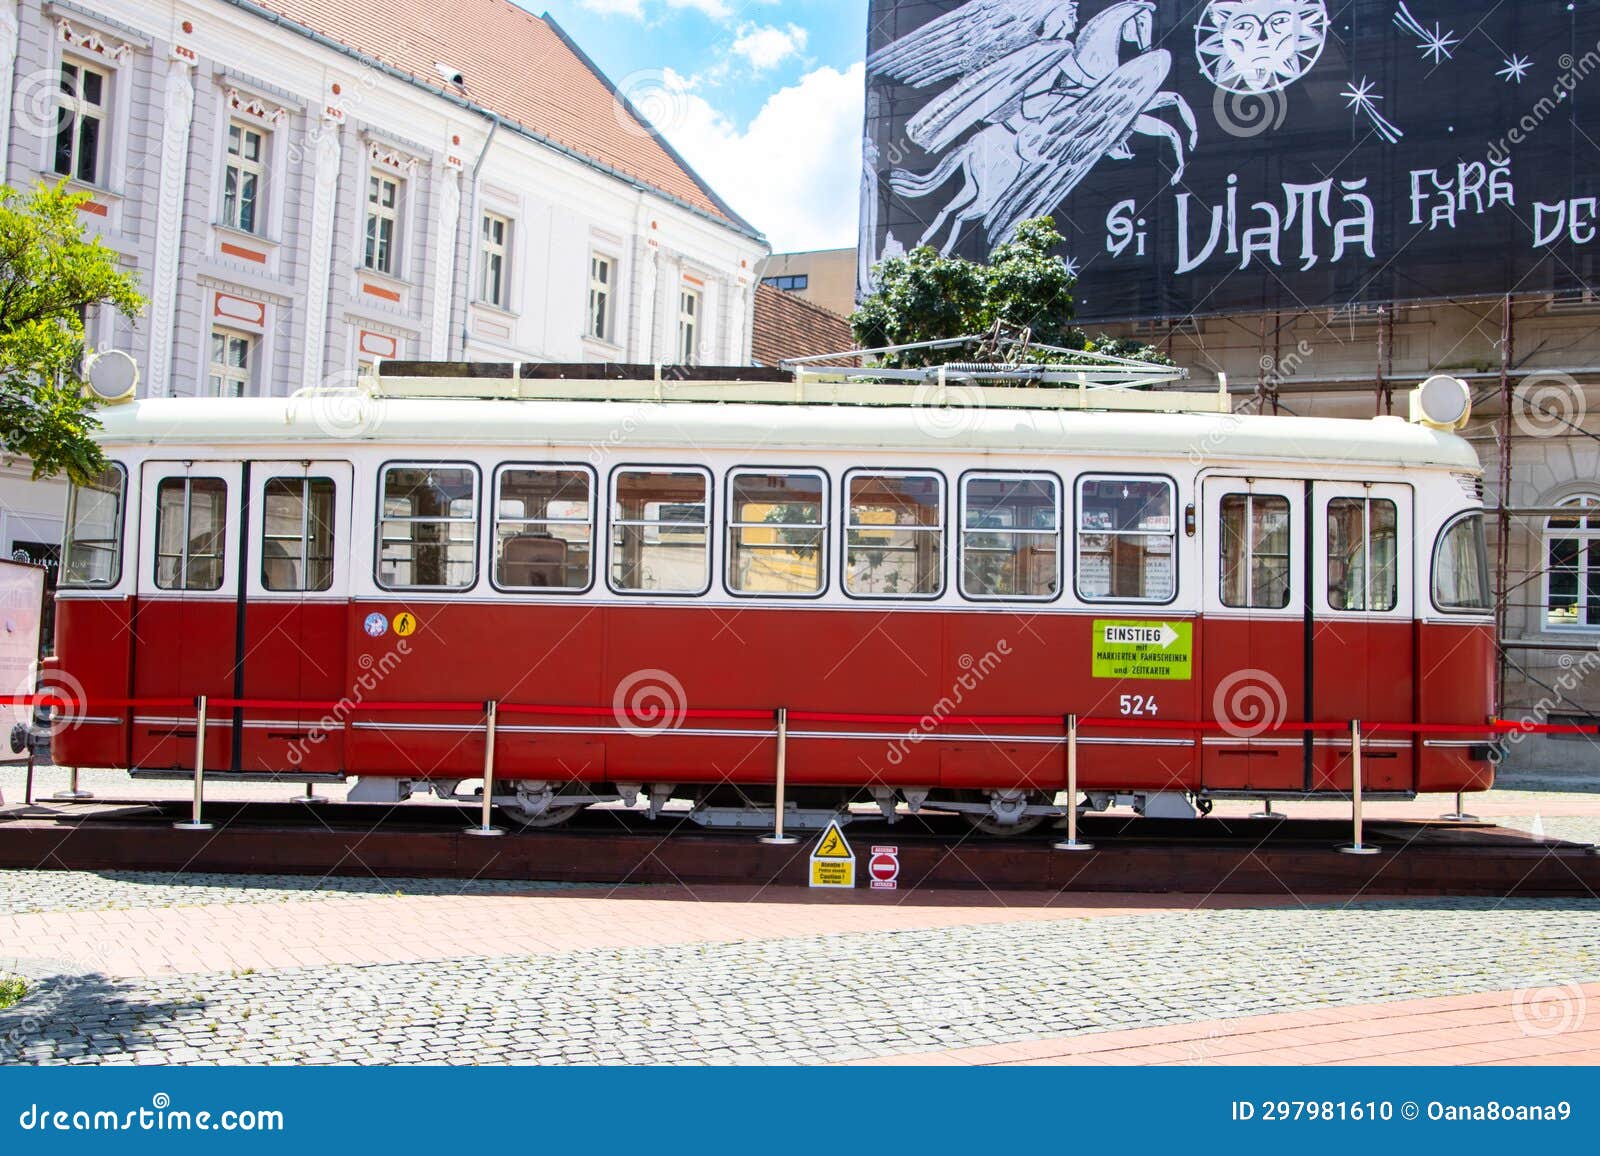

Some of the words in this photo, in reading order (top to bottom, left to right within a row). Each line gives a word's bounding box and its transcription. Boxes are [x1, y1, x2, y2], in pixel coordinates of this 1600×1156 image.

[1532, 197, 1597, 248] DE
[1106, 628, 1160, 641] EINSTIEG
[1135, 644, 1148, 652] mit
[1096, 652, 1137, 661] MARKIERTEN
[1140, 652, 1188, 663] FAHRSCHEINEN
[1113, 666, 1128, 674] und
[1132, 666, 1170, 675] ZEITKARTEN
[1119, 694, 1158, 716] 524
